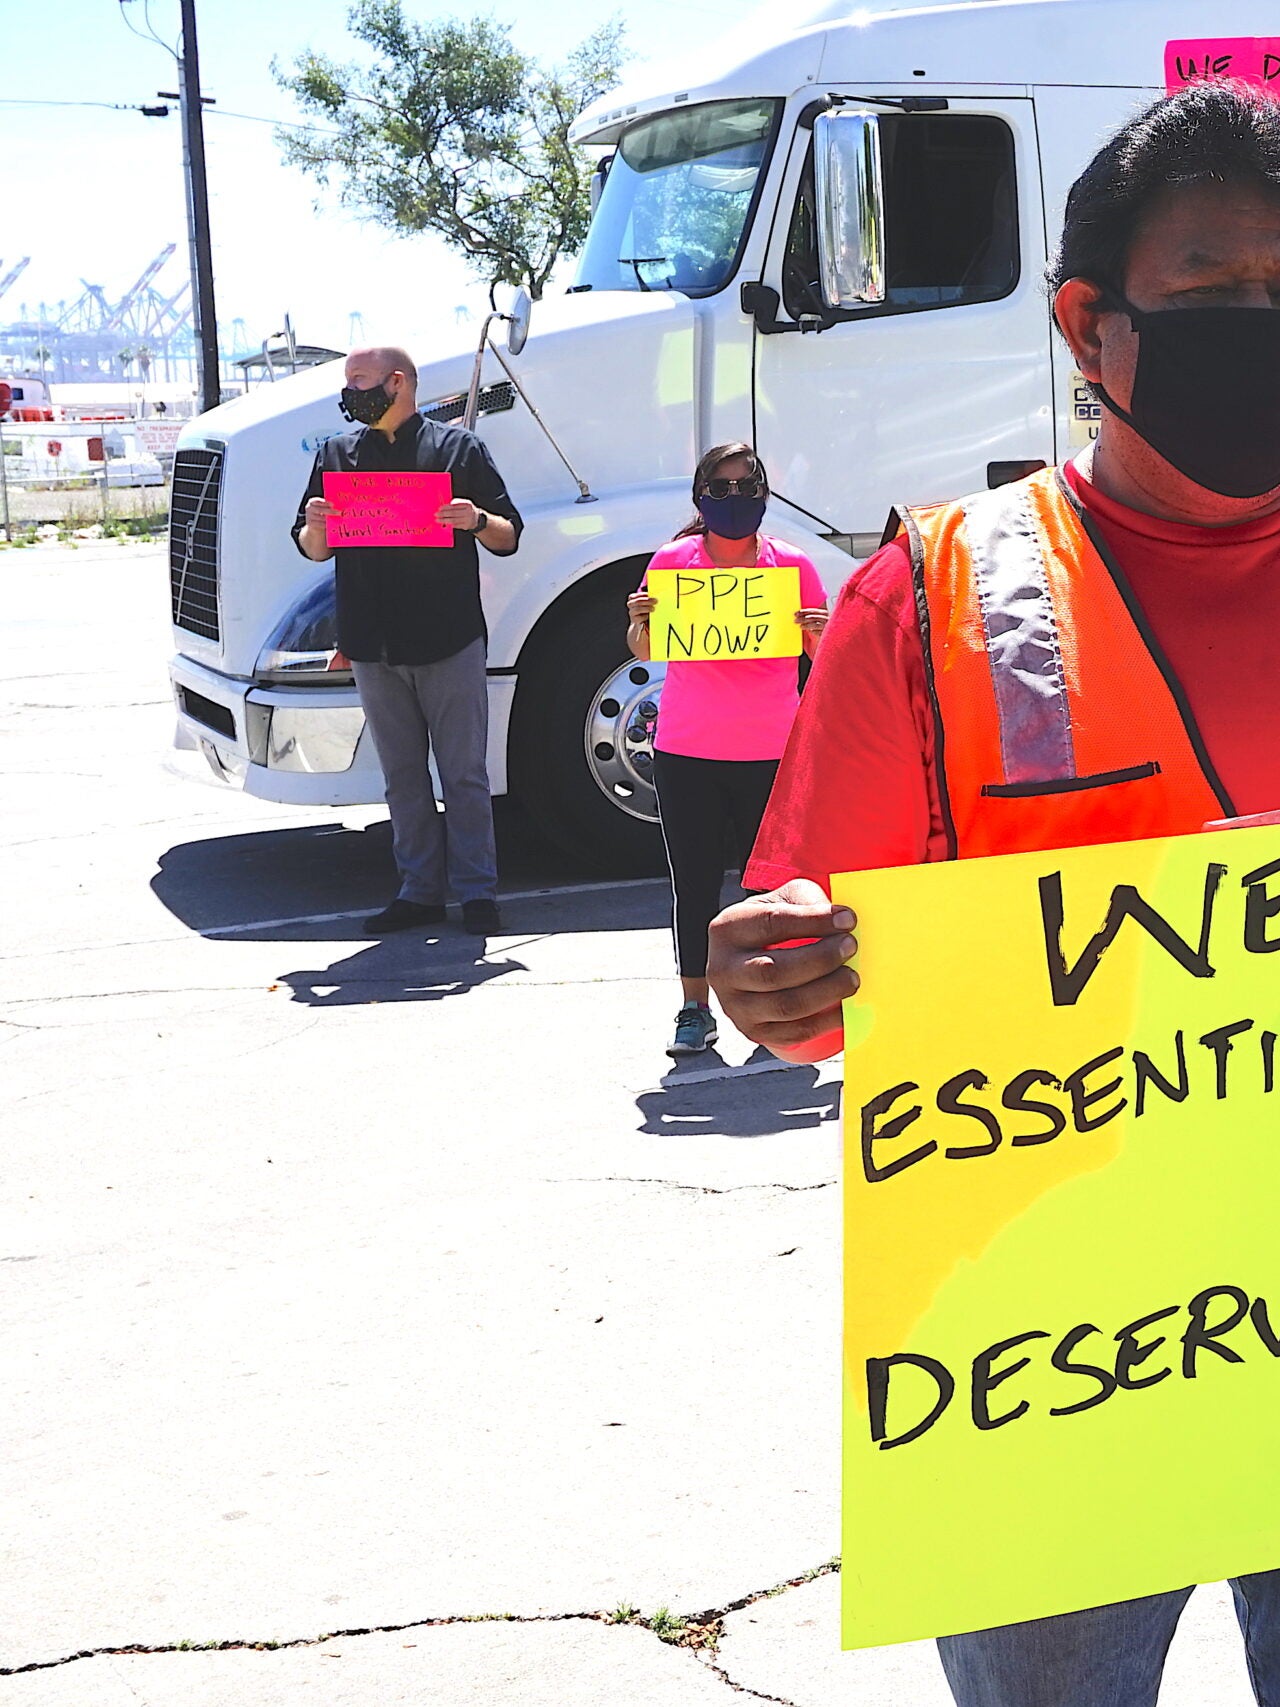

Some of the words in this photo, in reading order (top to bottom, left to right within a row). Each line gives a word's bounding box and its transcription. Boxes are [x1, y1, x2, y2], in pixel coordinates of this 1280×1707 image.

[1175, 54, 1232, 80] WE
[676, 573, 771, 618] PPE
[666, 623, 769, 659] NOW!
